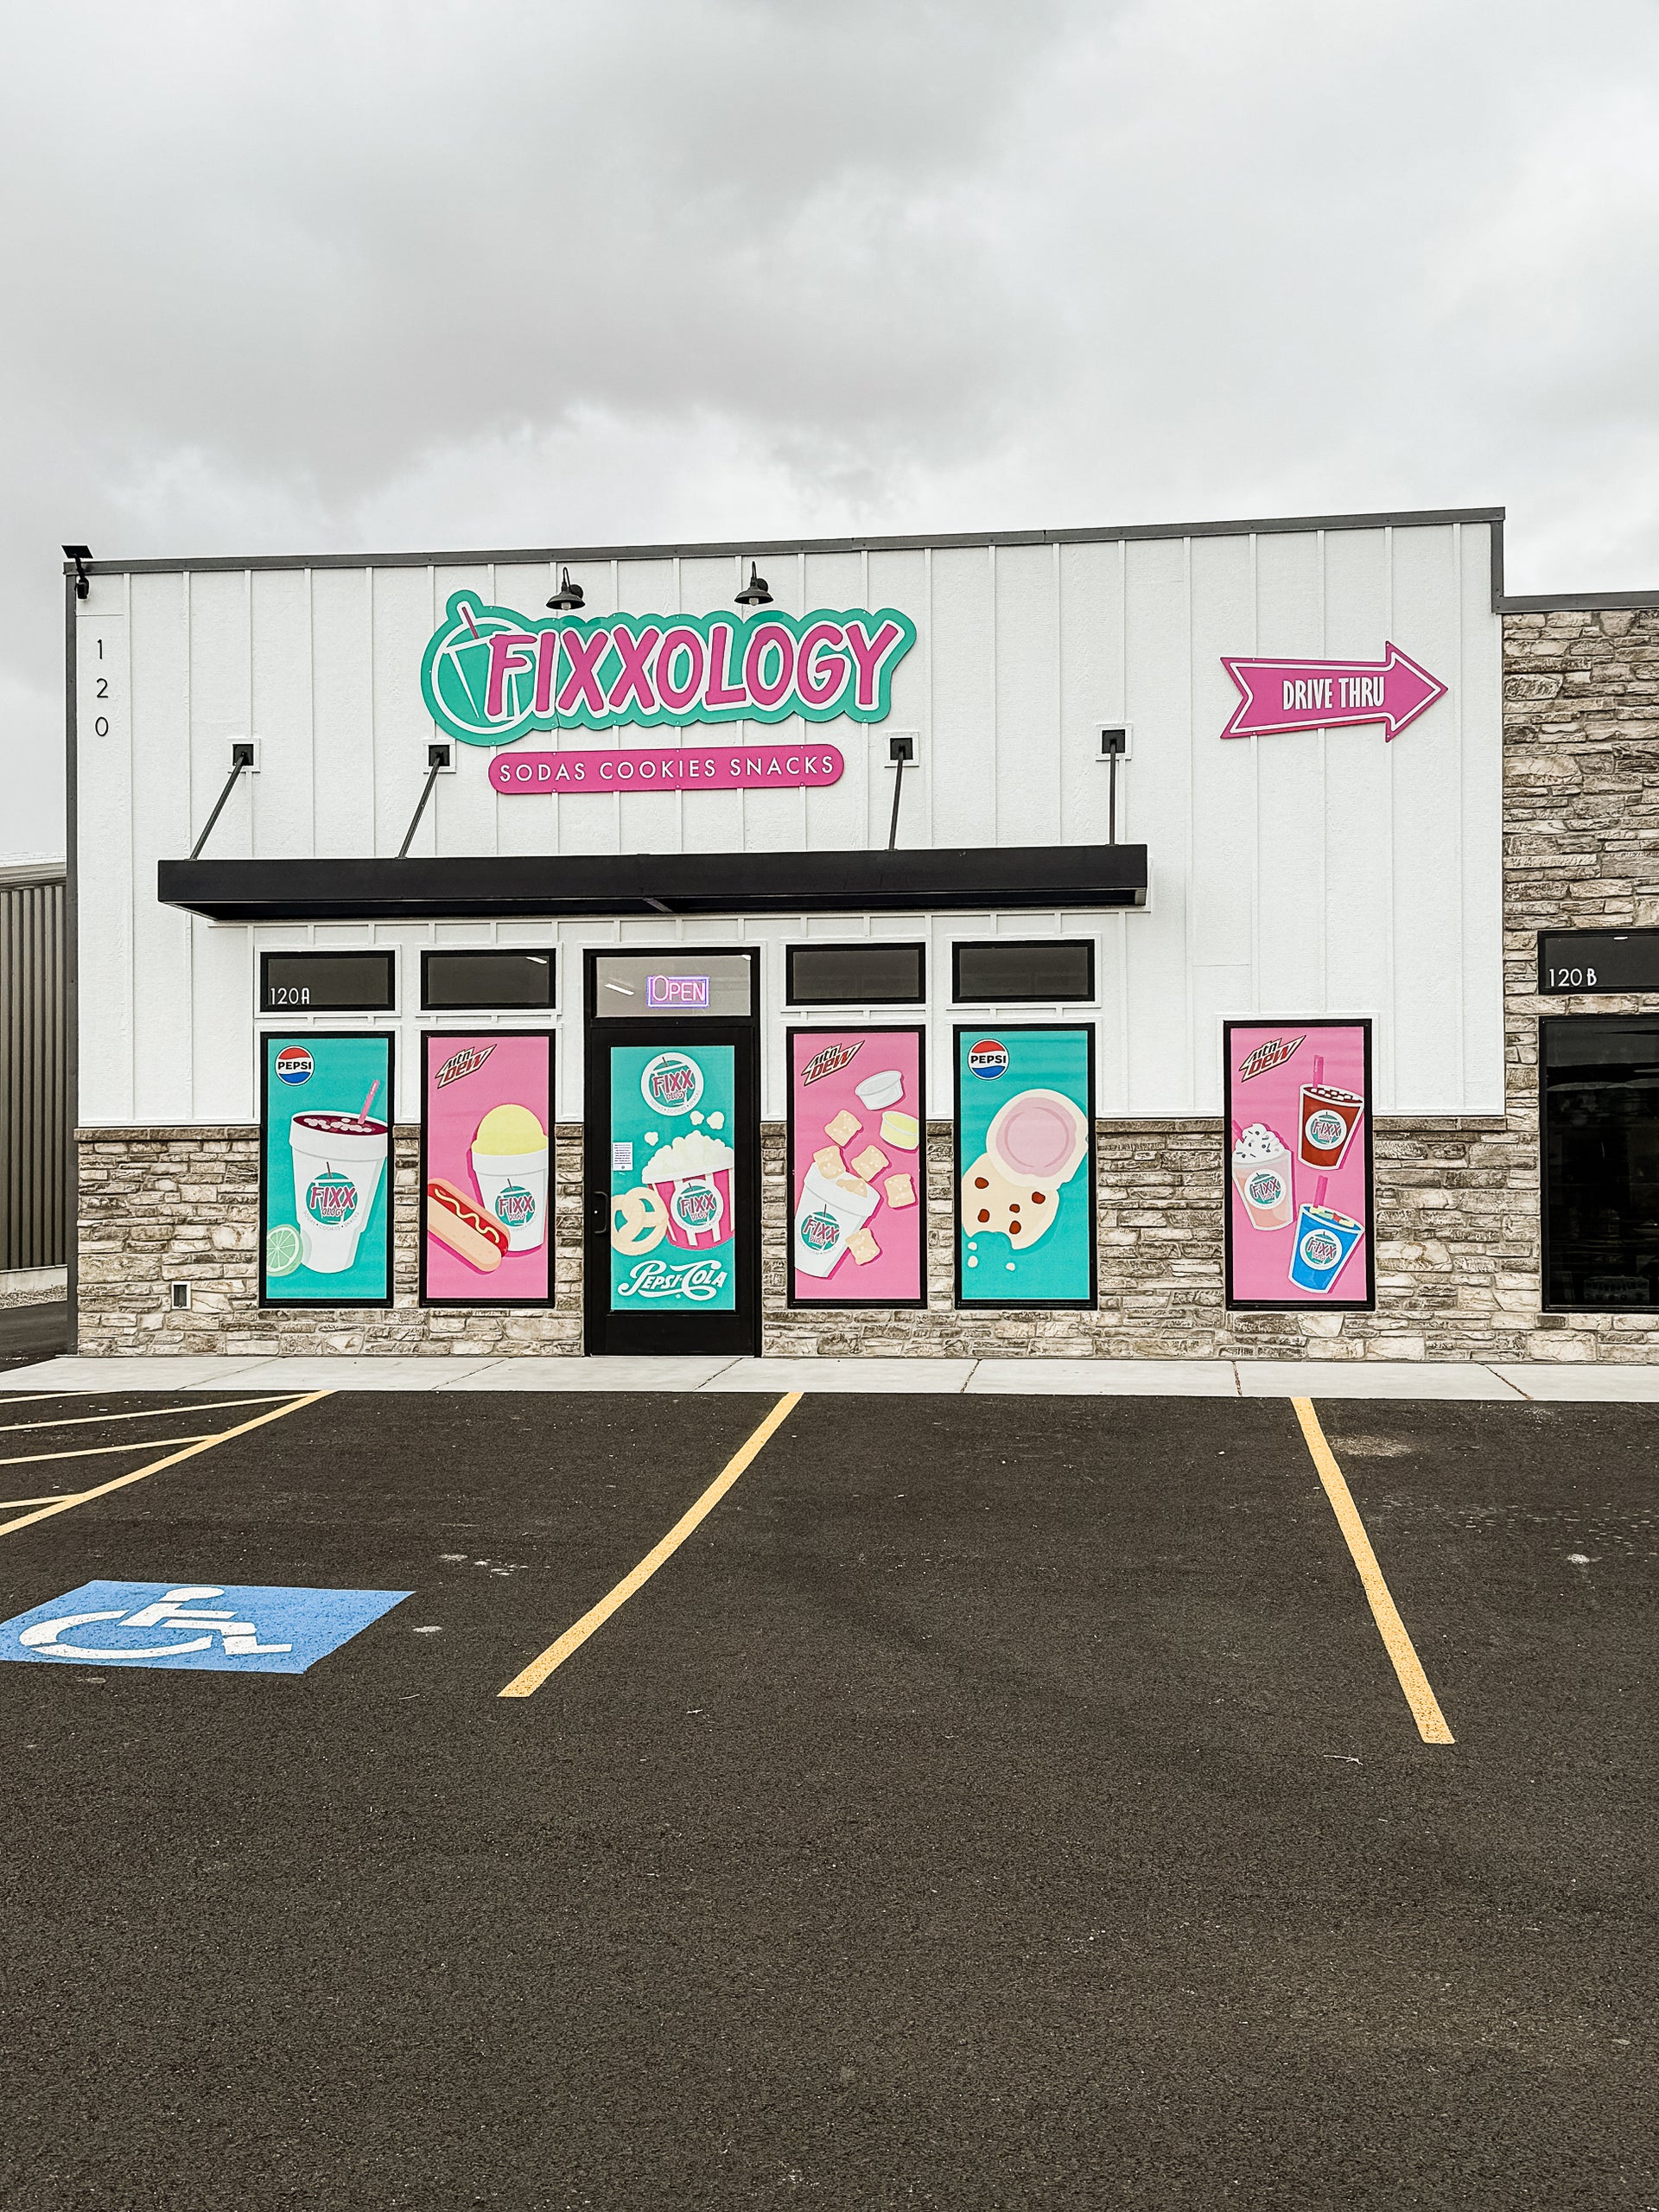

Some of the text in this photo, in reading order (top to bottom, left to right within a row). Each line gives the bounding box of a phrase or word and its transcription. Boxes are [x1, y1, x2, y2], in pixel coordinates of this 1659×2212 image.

[483, 621, 900, 718] FIXXOLOGY
[1283, 676, 1385, 710] DRIVE THRU
[499, 755, 835, 783] SODAS COOKIES SNACKS
[270, 988, 310, 1005] 120A
[652, 975, 706, 1001] OPEN
[277, 1061, 312, 1071] PEPSI
[970, 1055, 1007, 1064] PEPSI
[652, 1070, 694, 1096] FIXX
[1313, 1122, 1341, 1137] FIXX
[311, 1186, 356, 1208] FIXX
[1253, 1179, 1280, 1198] FIXX
[499, 1195, 533, 1216] FIXX
[681, 1193, 715, 1216] FIXX
[804, 1219, 839, 1243] FIXX
[1307, 1240, 1337, 1258] FIXX
